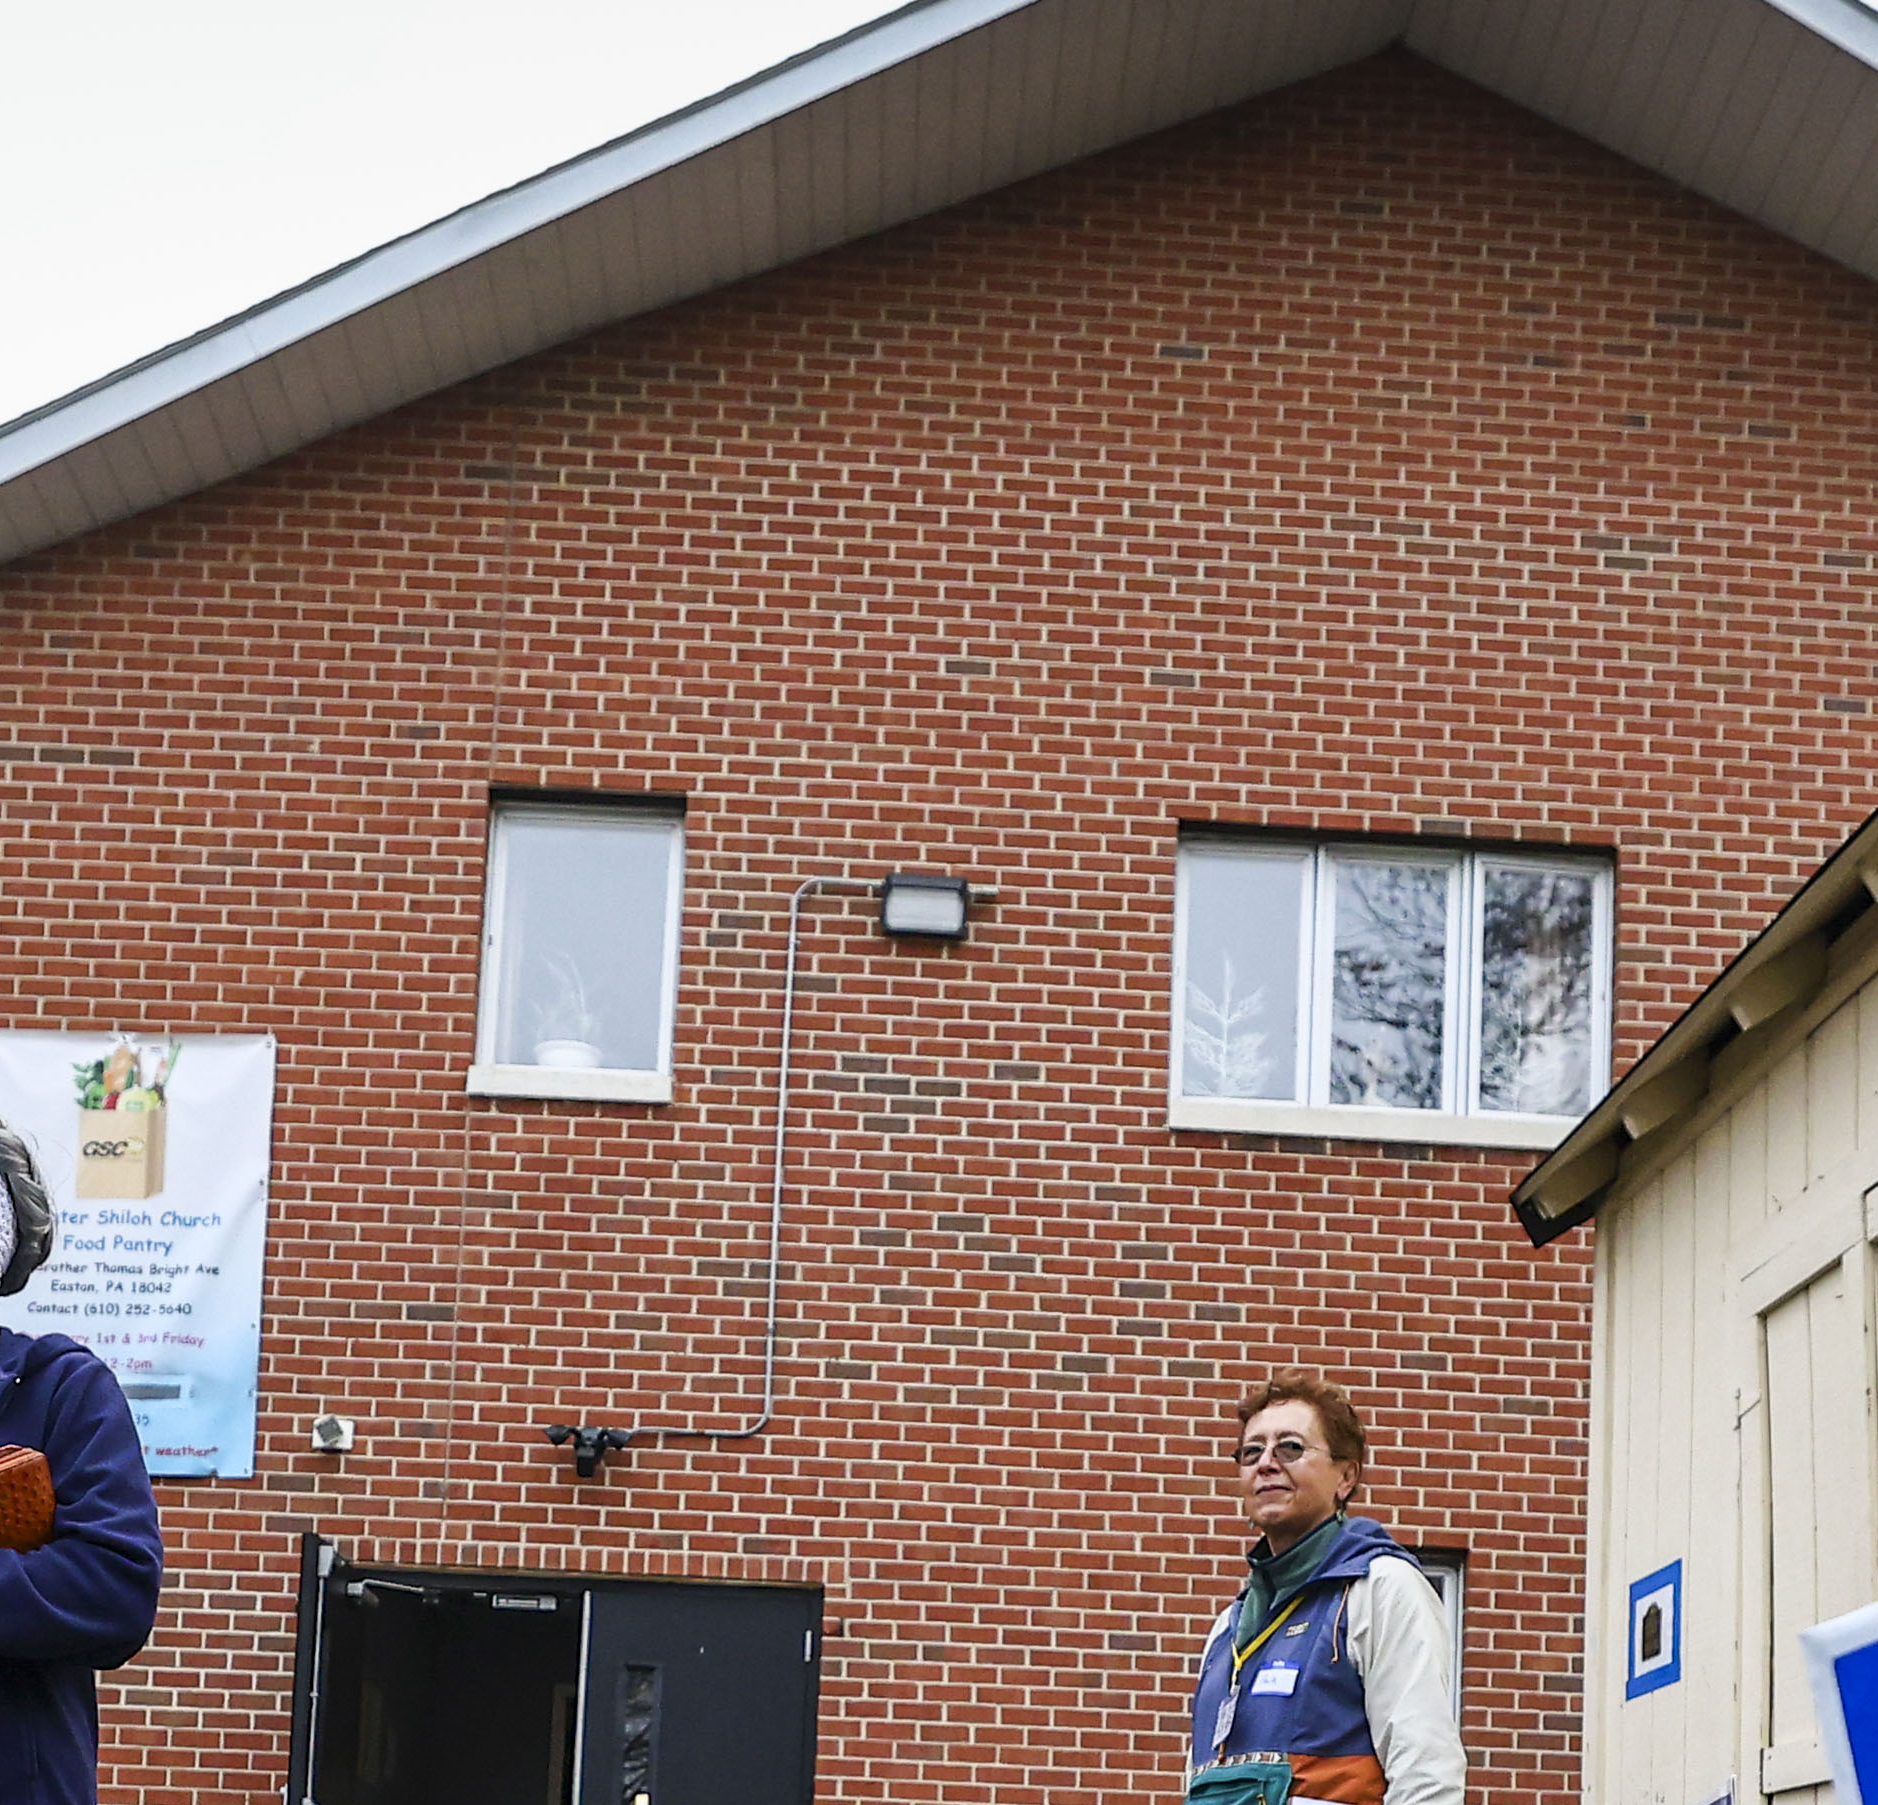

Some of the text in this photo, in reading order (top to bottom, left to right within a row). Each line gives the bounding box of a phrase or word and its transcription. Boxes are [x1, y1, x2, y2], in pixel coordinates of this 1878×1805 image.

[83, 1141, 127, 1157] GSC
[97, 1210, 152, 1226] Shiloh
[160, 1211, 221, 1227] Church
[63, 1235, 173, 1257] Food Pantry
[94, 1262, 143, 1274] Thomas
[149, 1263, 189, 1278] Bright
[195, 1264, 220, 1276] Ave
[51, 1279, 172, 1294] Easton, PA 18042
[27, 1301, 78, 1315] Contact
[84, 1302, 120, 1316] (610)
[97, 1332, 116, 1344] 1st
[162, 1333, 205, 1348] Friday
